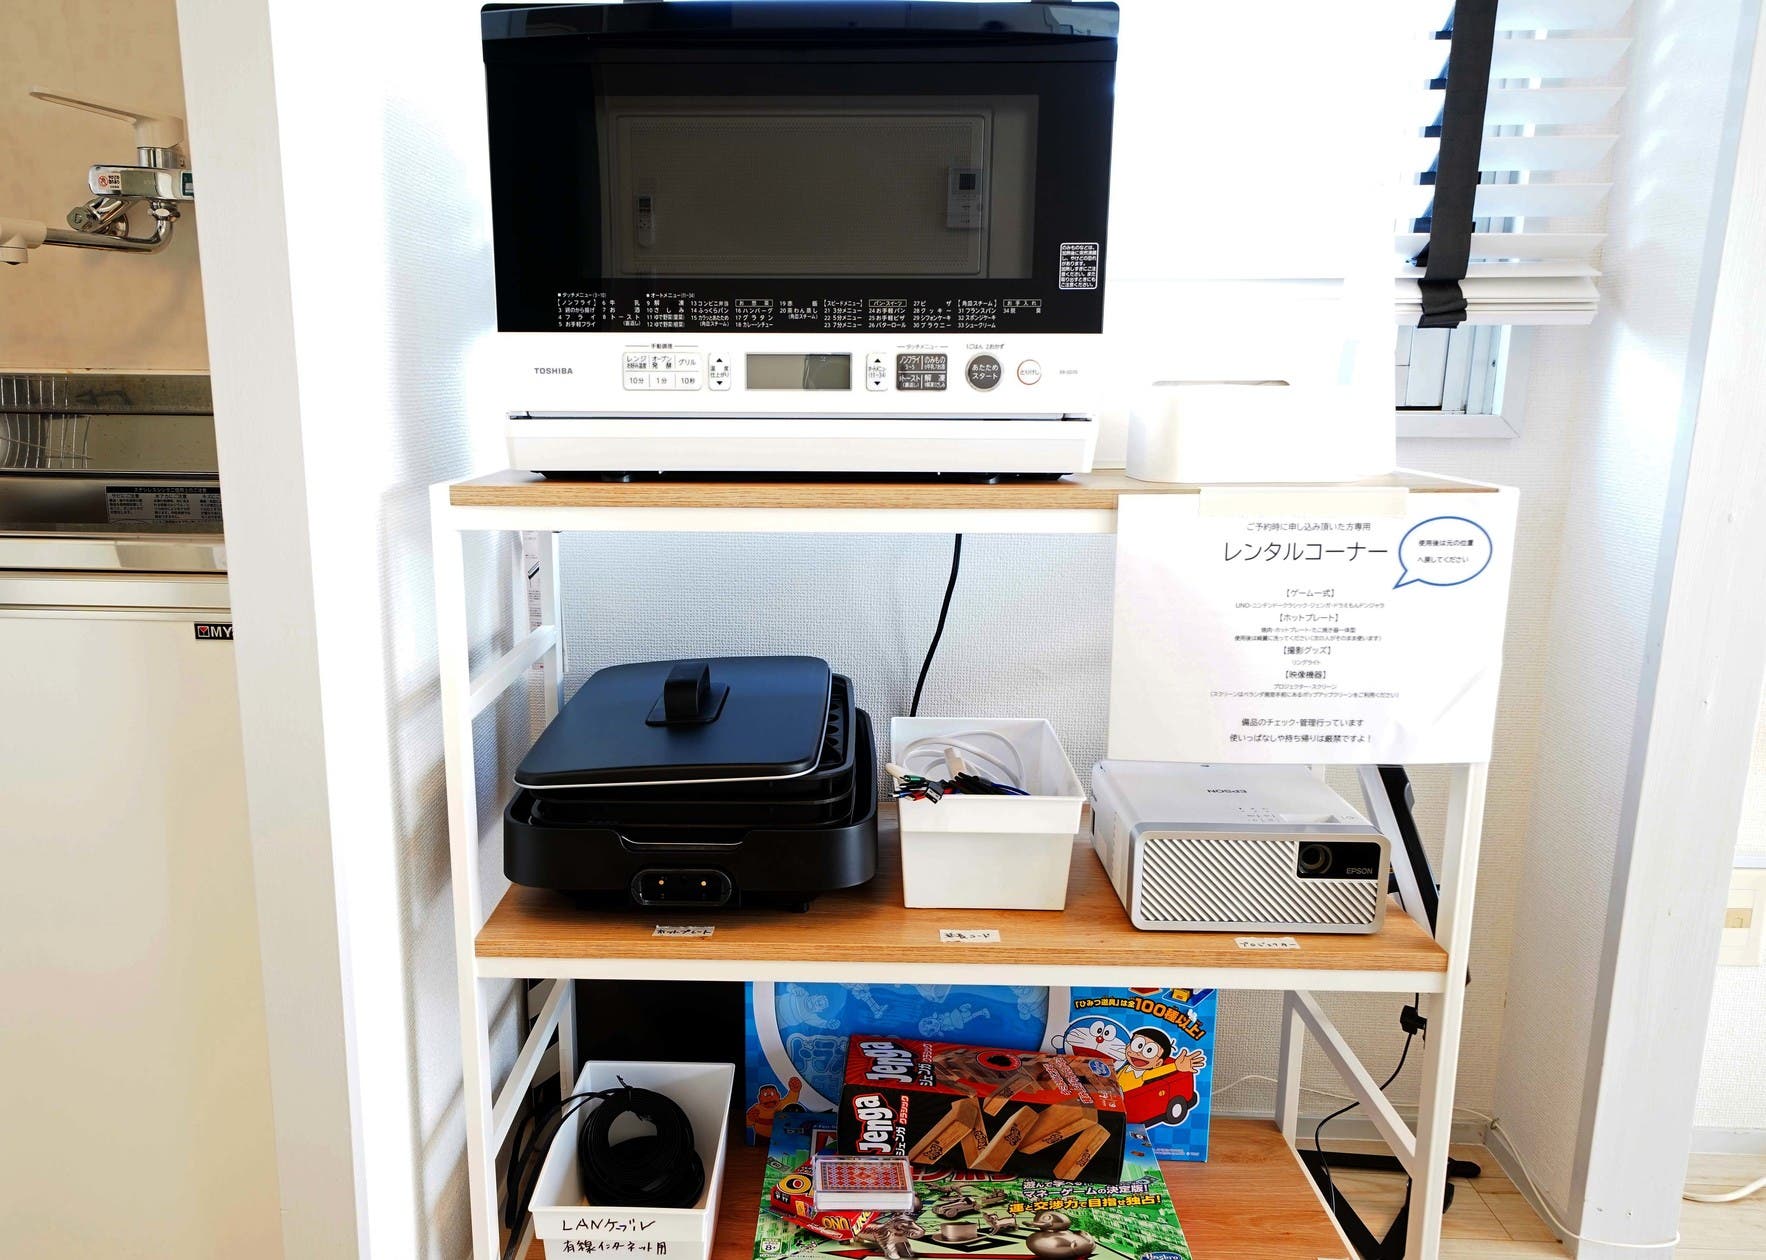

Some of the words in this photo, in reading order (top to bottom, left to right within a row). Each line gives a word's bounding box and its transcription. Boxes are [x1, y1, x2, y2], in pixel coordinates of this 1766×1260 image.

[534, 367, 574, 375] TOSHIBA
[972, 364, 999, 372] あたため
[1225, 541, 1388, 561] レンタルコーナー
[1346, 867, 1373, 875] EPSON
[860, 1041, 913, 1083] Jenga
[854, 1095, 894, 1153] Jenga
[822, 1215, 850, 1231] UNO
